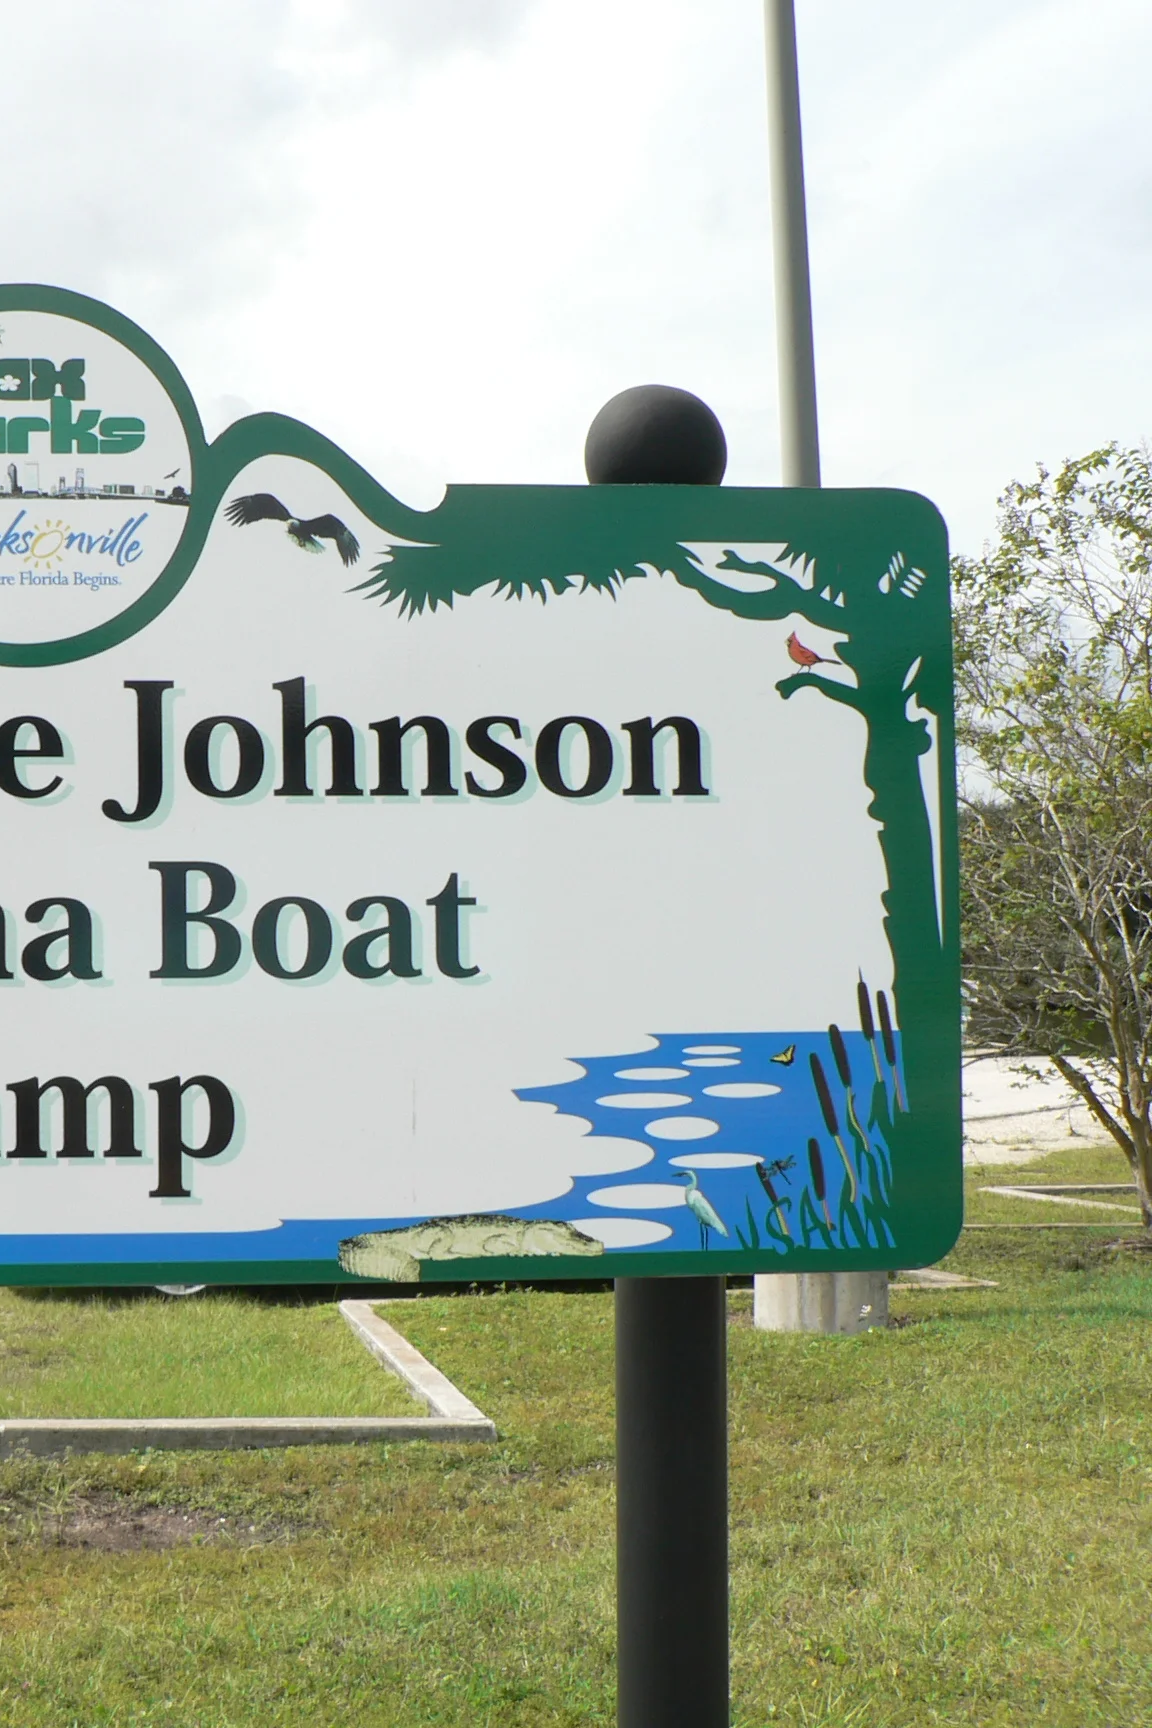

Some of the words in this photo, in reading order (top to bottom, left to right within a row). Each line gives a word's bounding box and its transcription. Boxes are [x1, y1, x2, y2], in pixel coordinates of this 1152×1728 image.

[19, 570, 70, 586] Florida
[73, 571, 122, 591] Begins.
[102, 677, 710, 823] Johnson
[148, 862, 480, 980] Boat
